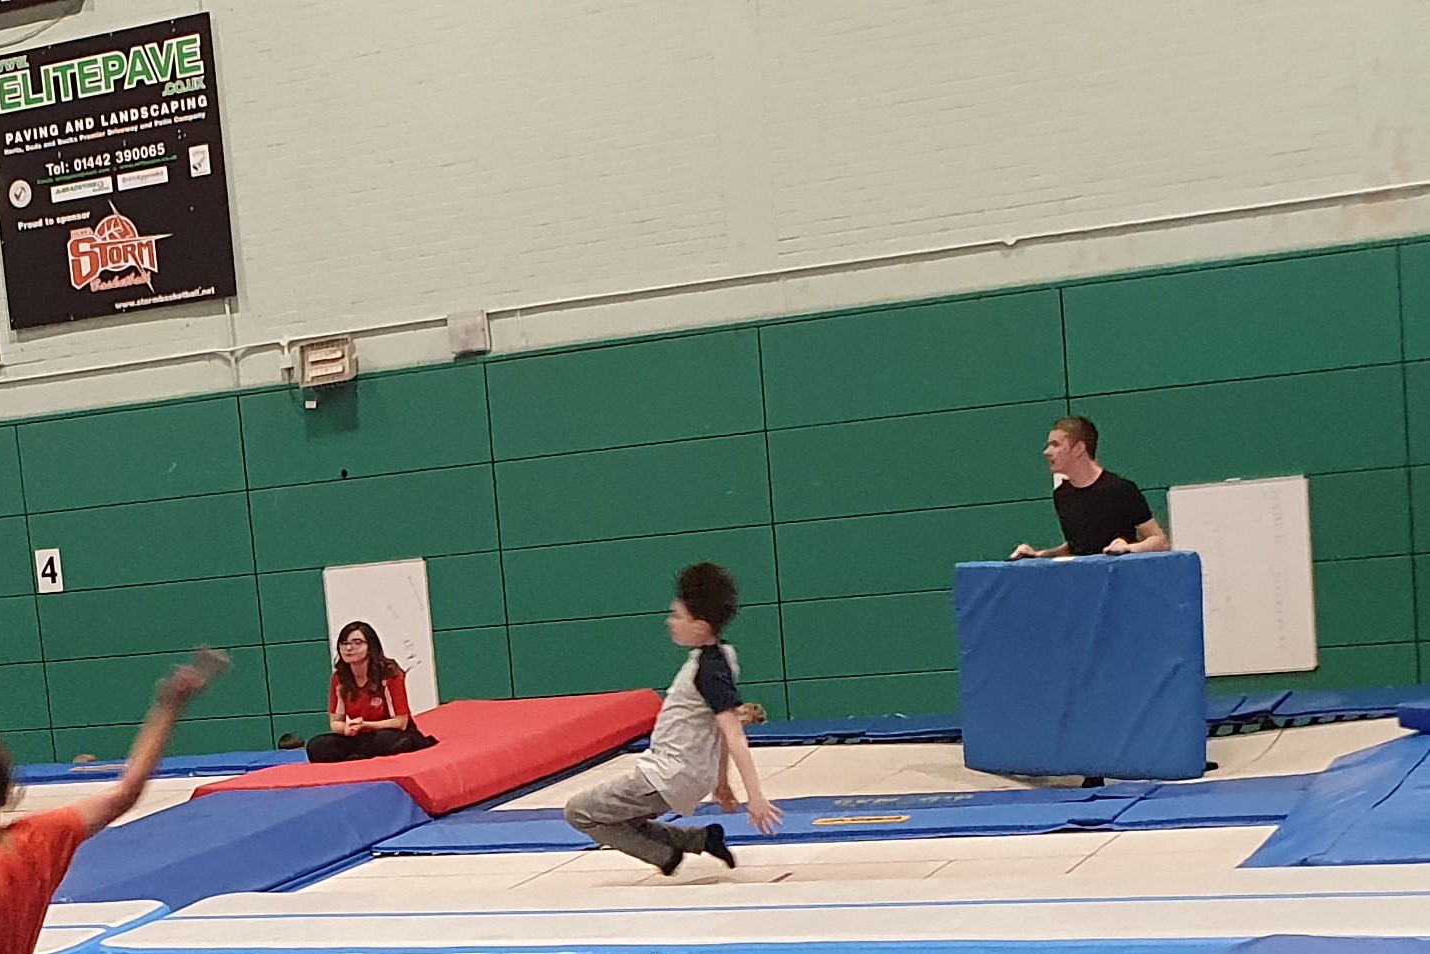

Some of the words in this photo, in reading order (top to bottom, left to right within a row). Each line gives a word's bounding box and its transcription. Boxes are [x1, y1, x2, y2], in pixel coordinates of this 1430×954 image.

[5, 124, 59, 145] PAVING
[65, 117, 94, 134] AND
[100, 94, 208, 127] LANDSCAPING
[45, 161, 70, 176] Tel:
[73, 153, 111, 172] 01442
[116, 142, 166, 163] 390065
[17, 218, 43, 231] Proud
[45, 217, 55, 226] to
[56, 211, 91, 224] sponsor
[41, 556, 58, 584] 4
